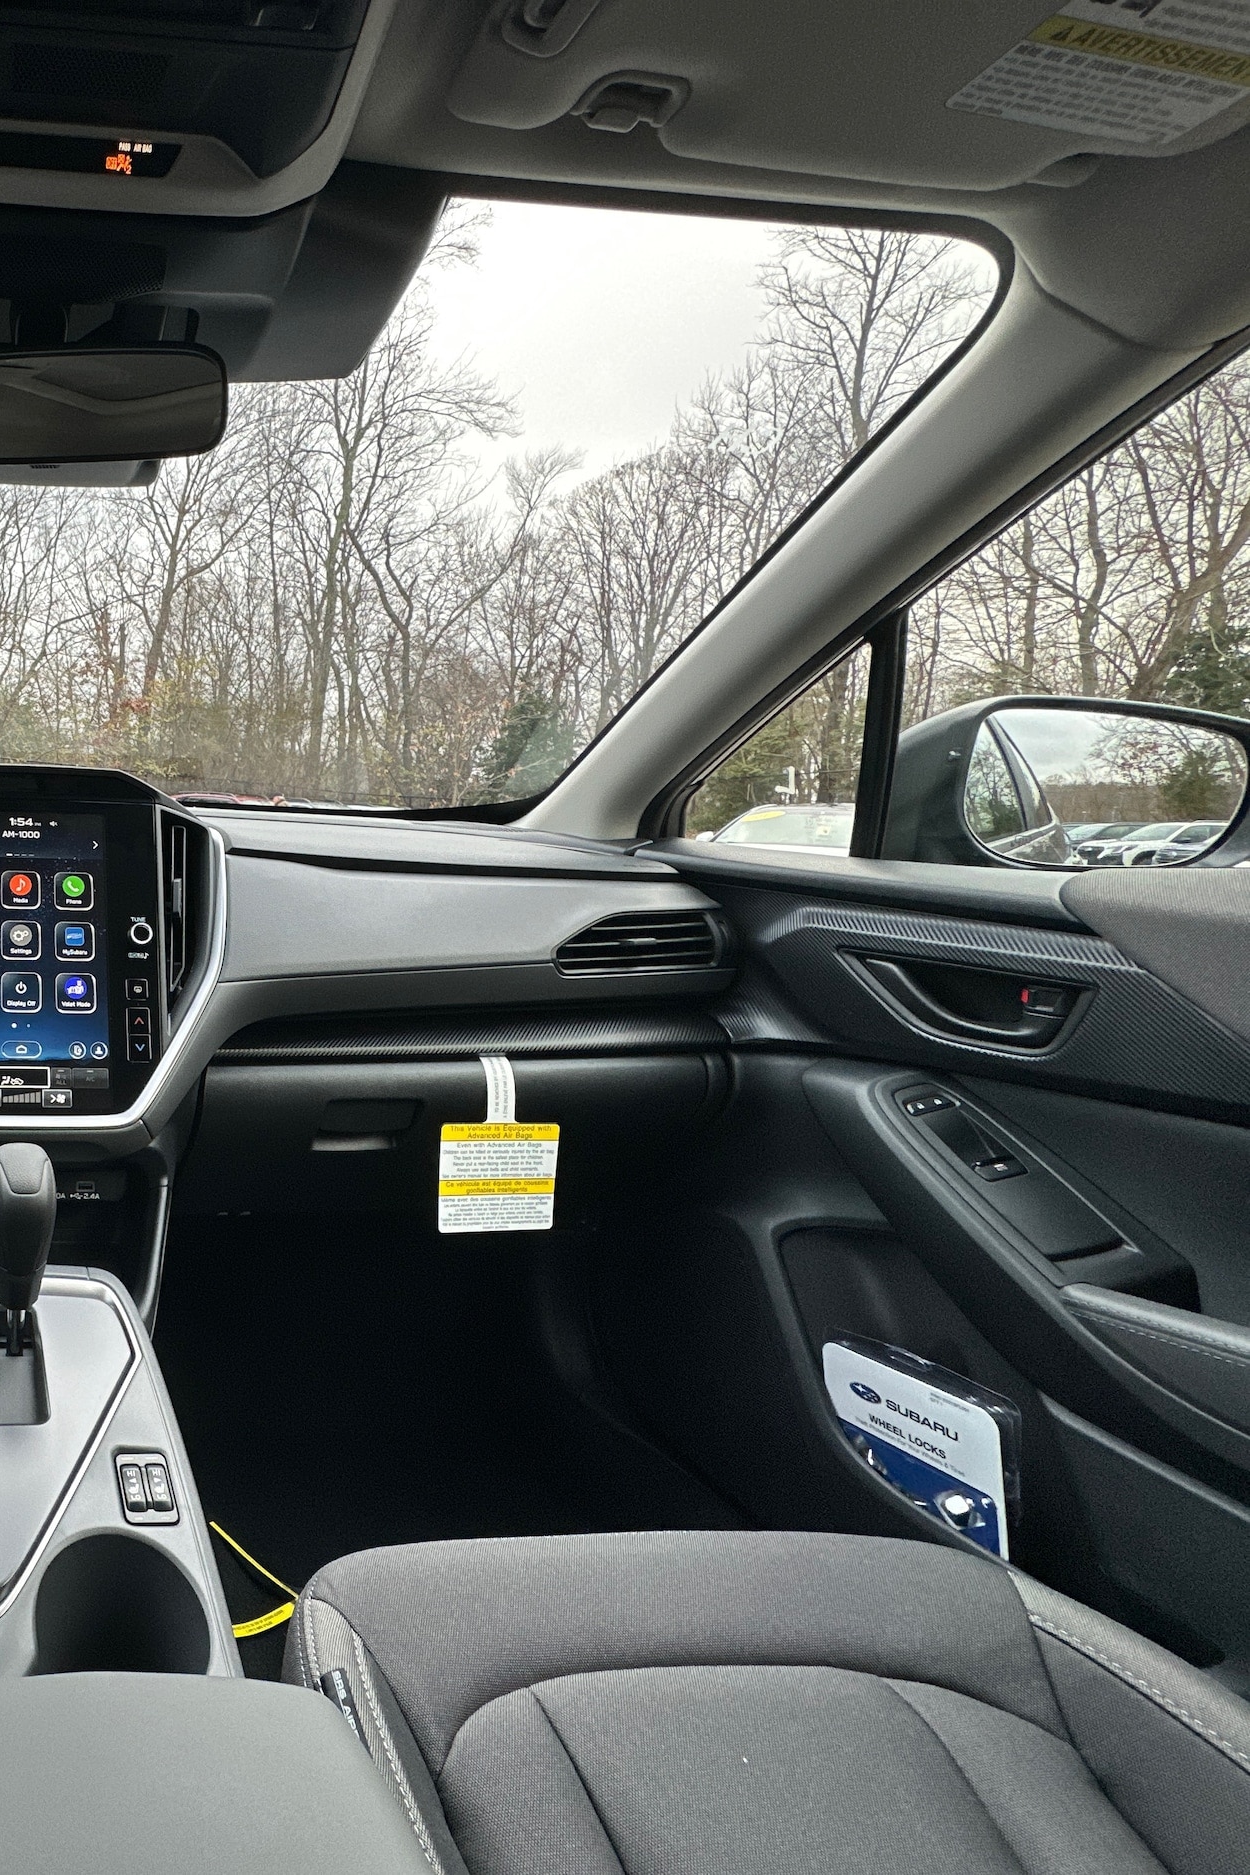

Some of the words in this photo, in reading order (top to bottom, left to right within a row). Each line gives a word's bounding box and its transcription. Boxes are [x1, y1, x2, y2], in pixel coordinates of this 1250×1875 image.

[1070, 27, 1250, 81] AVERTISSEMEN
[2, 831, 40, 839] AM-1000
[9, 818, 33, 826] 1:54
[868, 1412, 906, 1439] WHEEL
[908, 1434, 946, 1459] LOCKS
[885, 1399, 959, 1442] SUBARU
